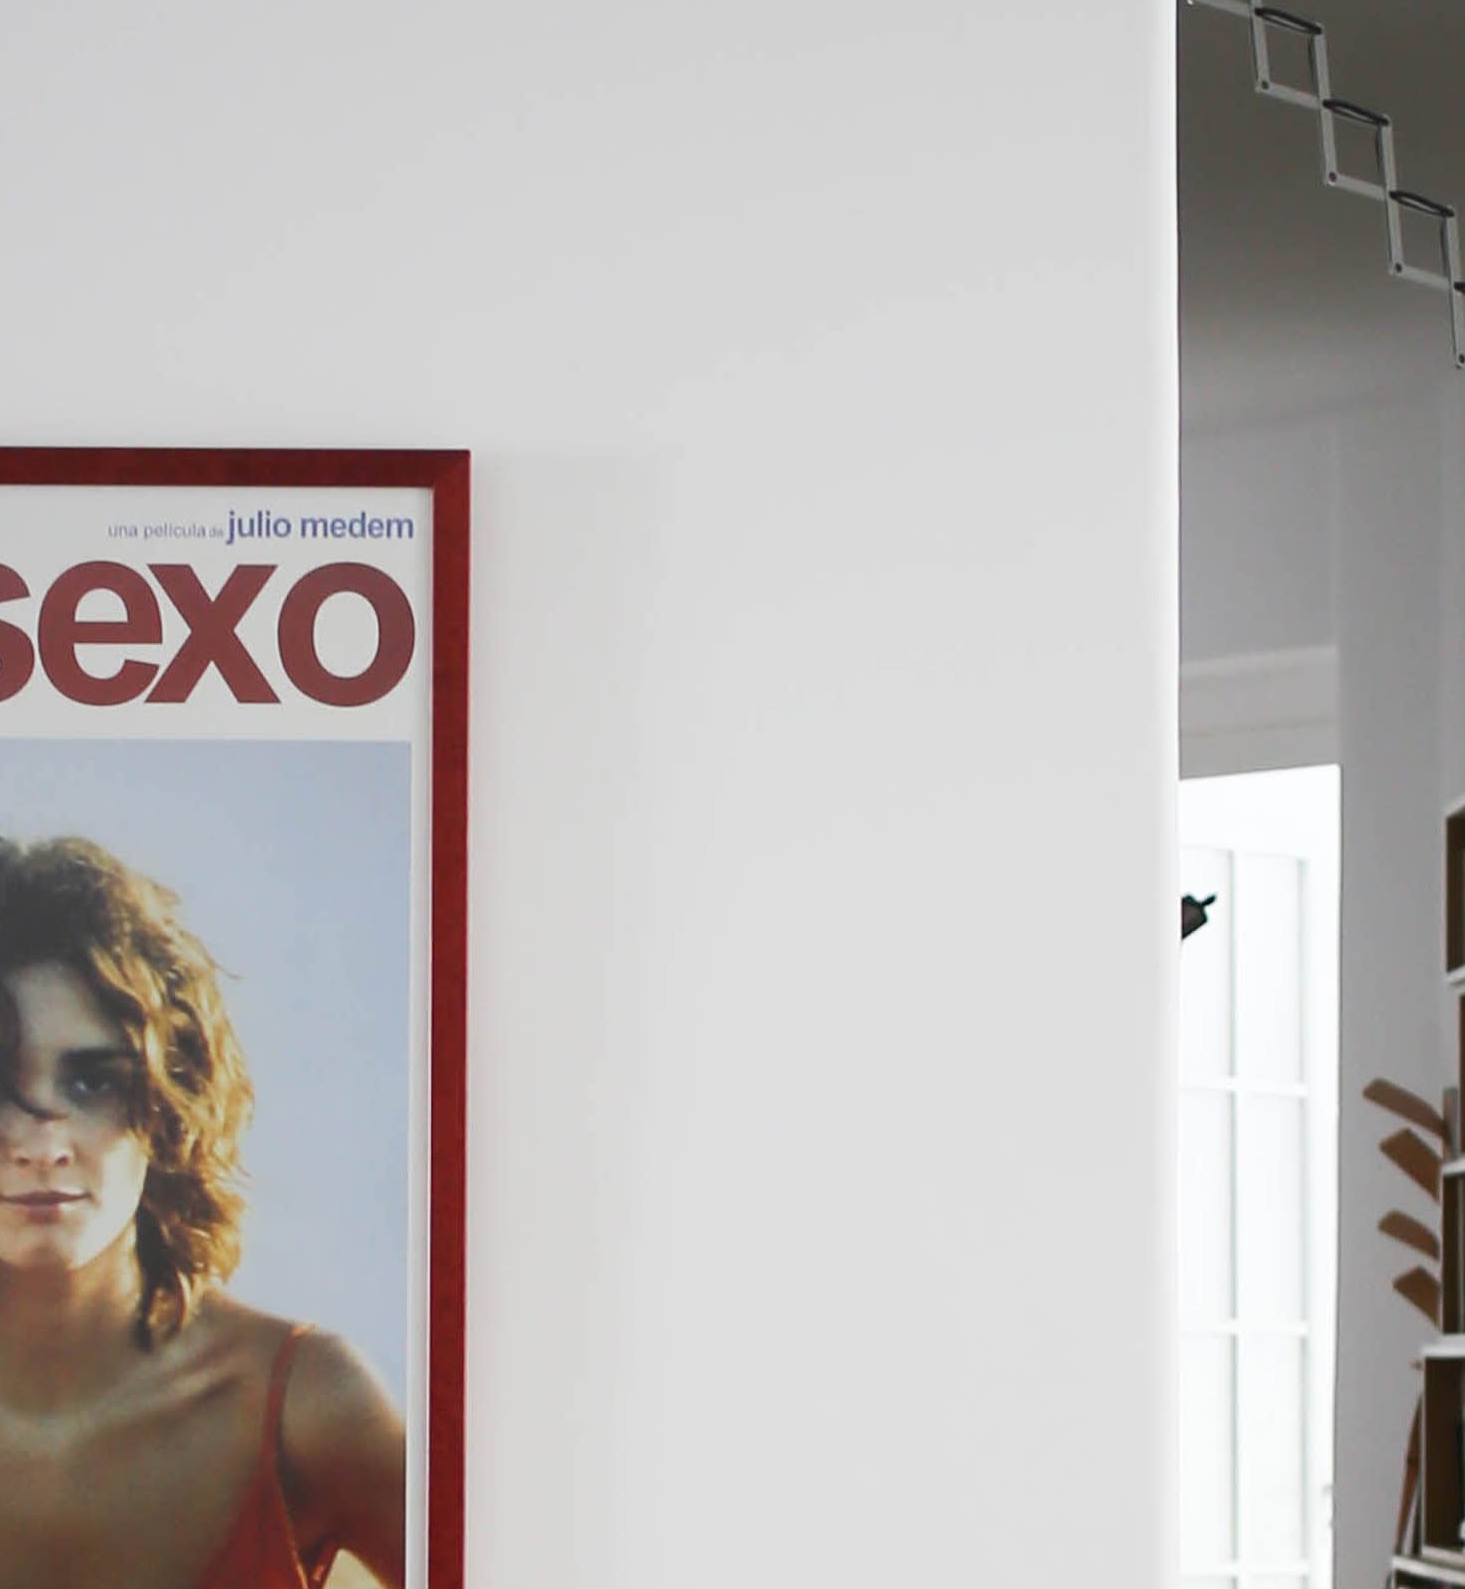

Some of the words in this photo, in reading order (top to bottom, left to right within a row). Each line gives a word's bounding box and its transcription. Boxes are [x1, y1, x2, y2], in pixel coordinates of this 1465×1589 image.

[107, 524, 138, 538] una
[226, 511, 292, 545] julio
[300, 511, 414, 539] medem
